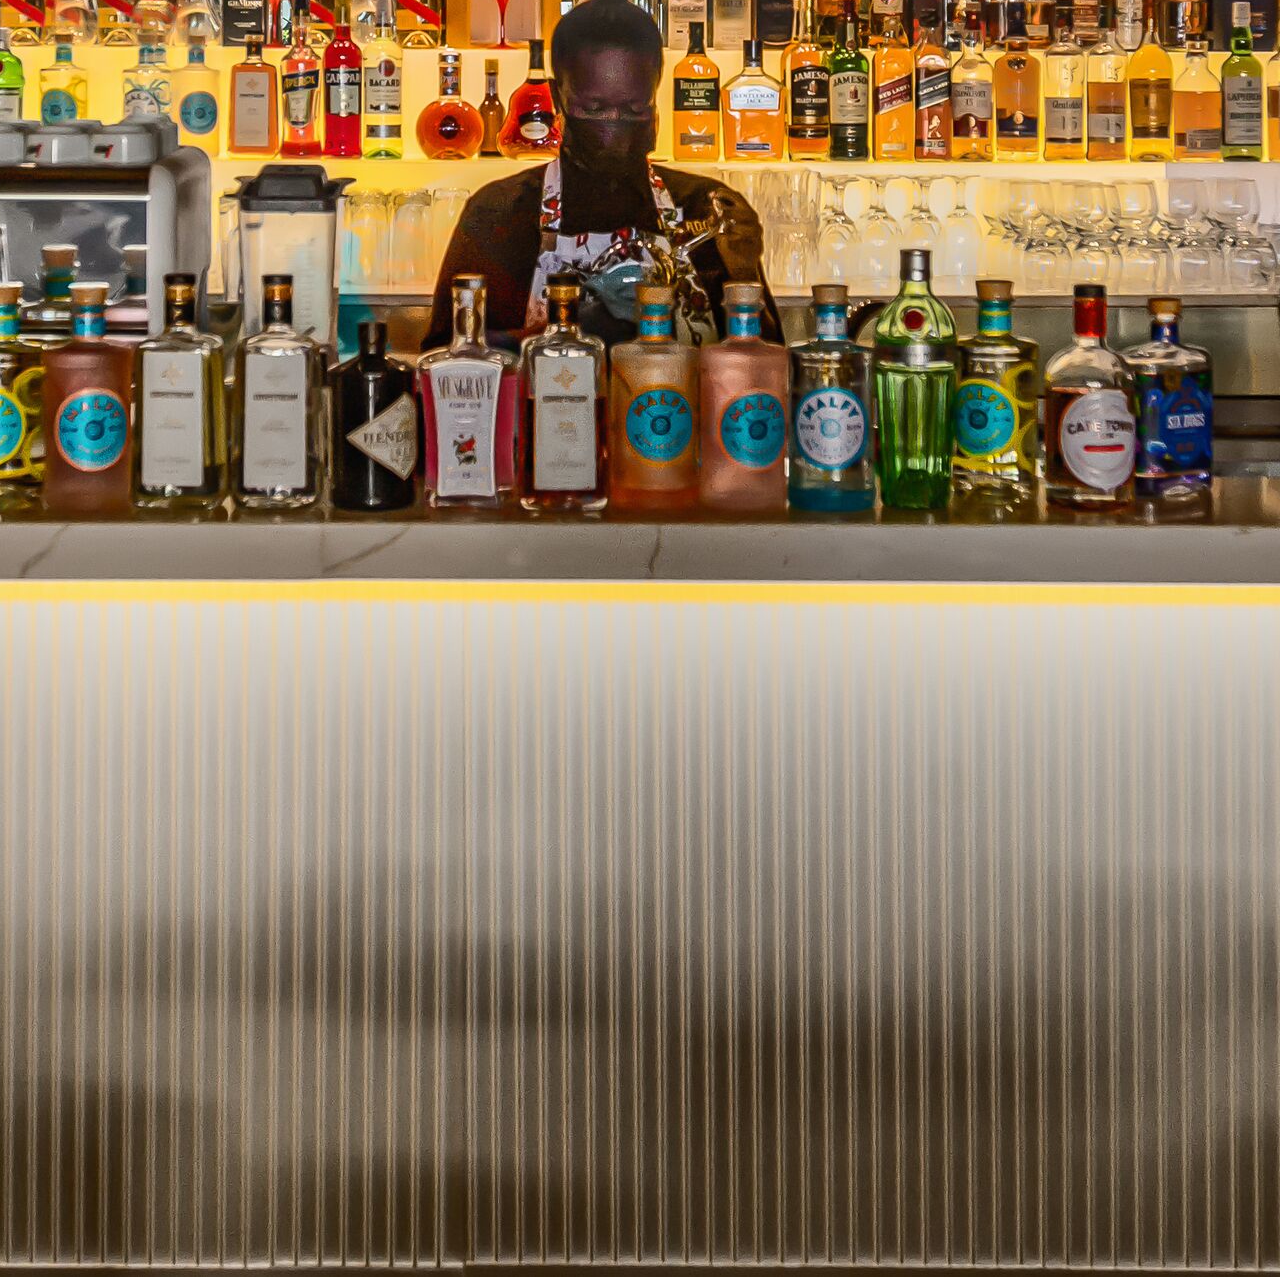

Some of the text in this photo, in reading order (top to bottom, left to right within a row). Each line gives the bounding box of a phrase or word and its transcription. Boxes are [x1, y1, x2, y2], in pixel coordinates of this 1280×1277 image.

[794, 72, 829, 82] JAMESO
[833, 75, 867, 87] JAMESO
[369, 79, 401, 87] BACARD
[802, 396, 861, 420] MALFY
